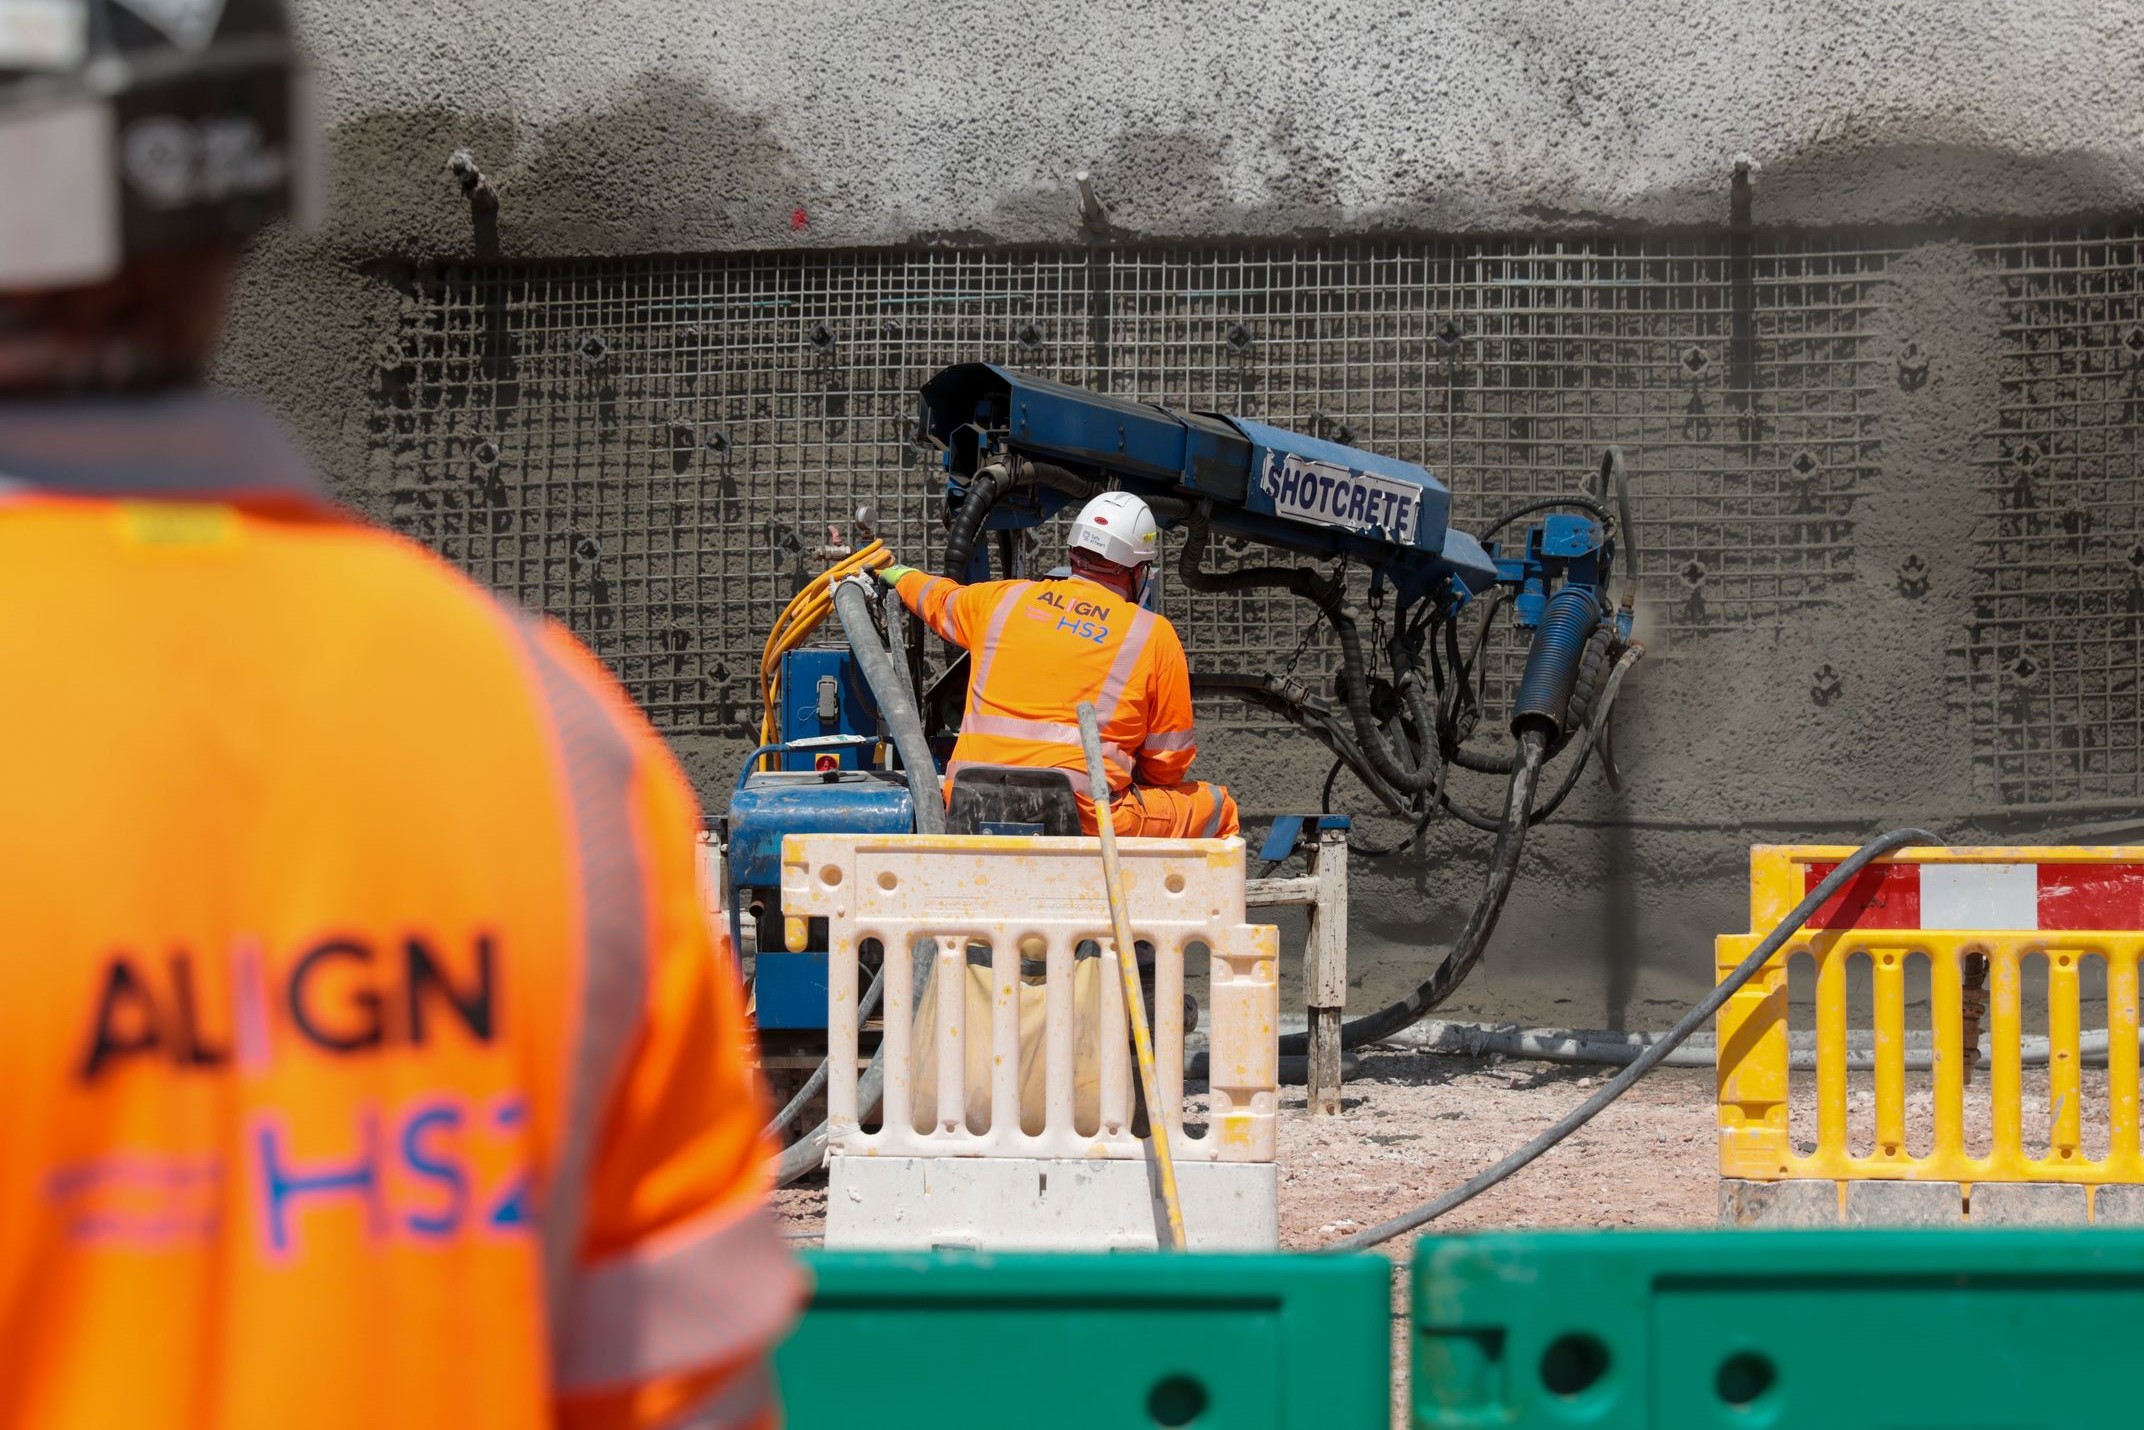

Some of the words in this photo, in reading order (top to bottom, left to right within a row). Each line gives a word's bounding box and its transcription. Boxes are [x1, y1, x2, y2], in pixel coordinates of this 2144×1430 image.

[1268, 465, 1412, 531] SHOTCRETE
[1036, 591, 1110, 621] ALIGN
[1056, 616, 1108, 644] HS2
[78, 932, 497, 1084] ALIGN
